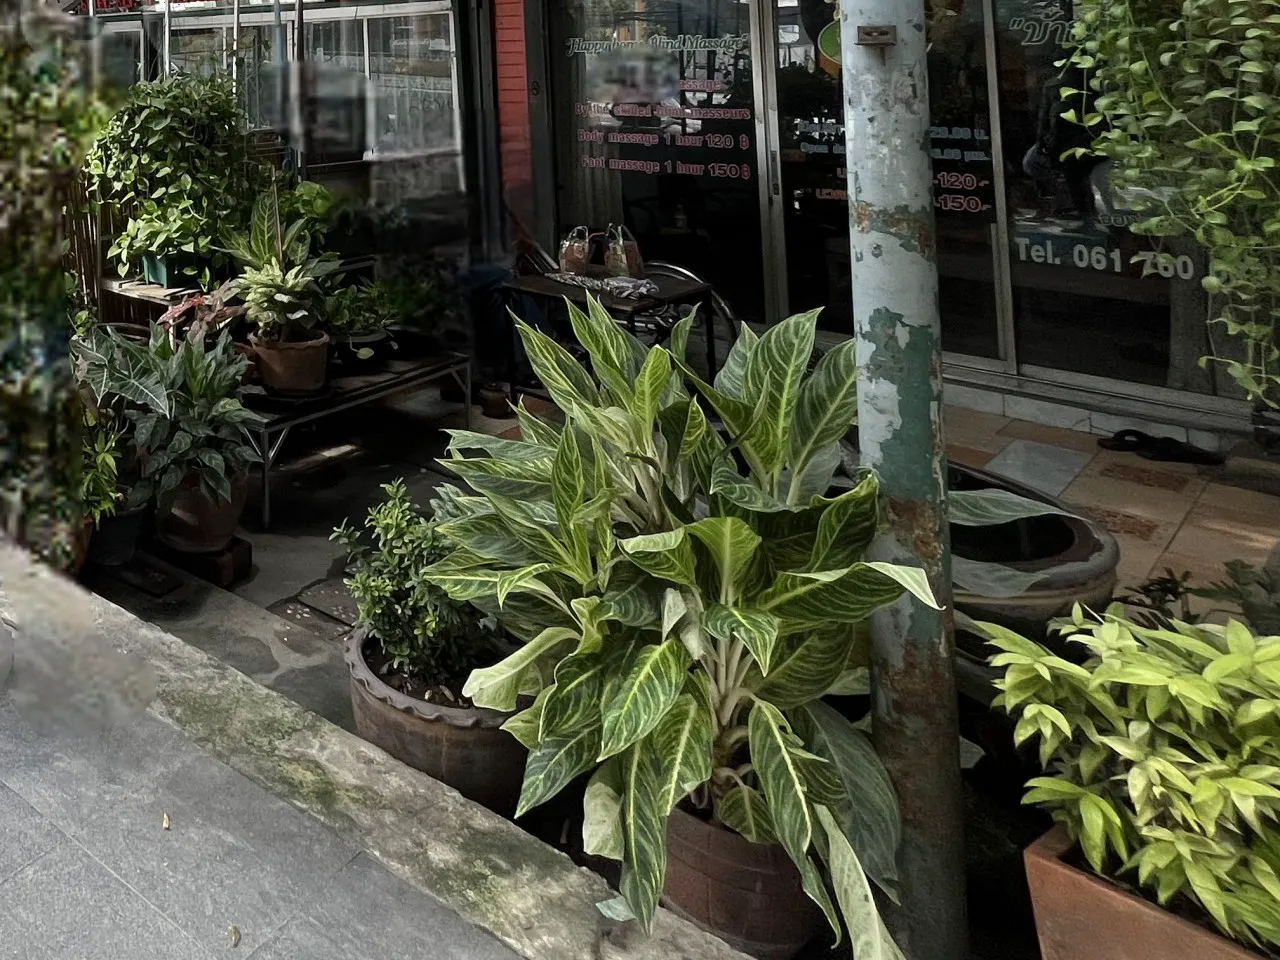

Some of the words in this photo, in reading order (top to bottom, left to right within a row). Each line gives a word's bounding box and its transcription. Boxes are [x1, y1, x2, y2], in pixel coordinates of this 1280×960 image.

[690, 107, 751, 120] masseurs
[577, 128, 604, 144] Body
[608, 132, 659, 146] massage
[675, 133, 703, 148] hour
[706, 134, 734, 149] 120
[609, 159, 660, 174] massage
[676, 160, 705, 175] hour
[707, 163, 740, 179] 150
[1015, 237, 1061, 265] Tel.
[1073, 243, 1122, 273] 061
